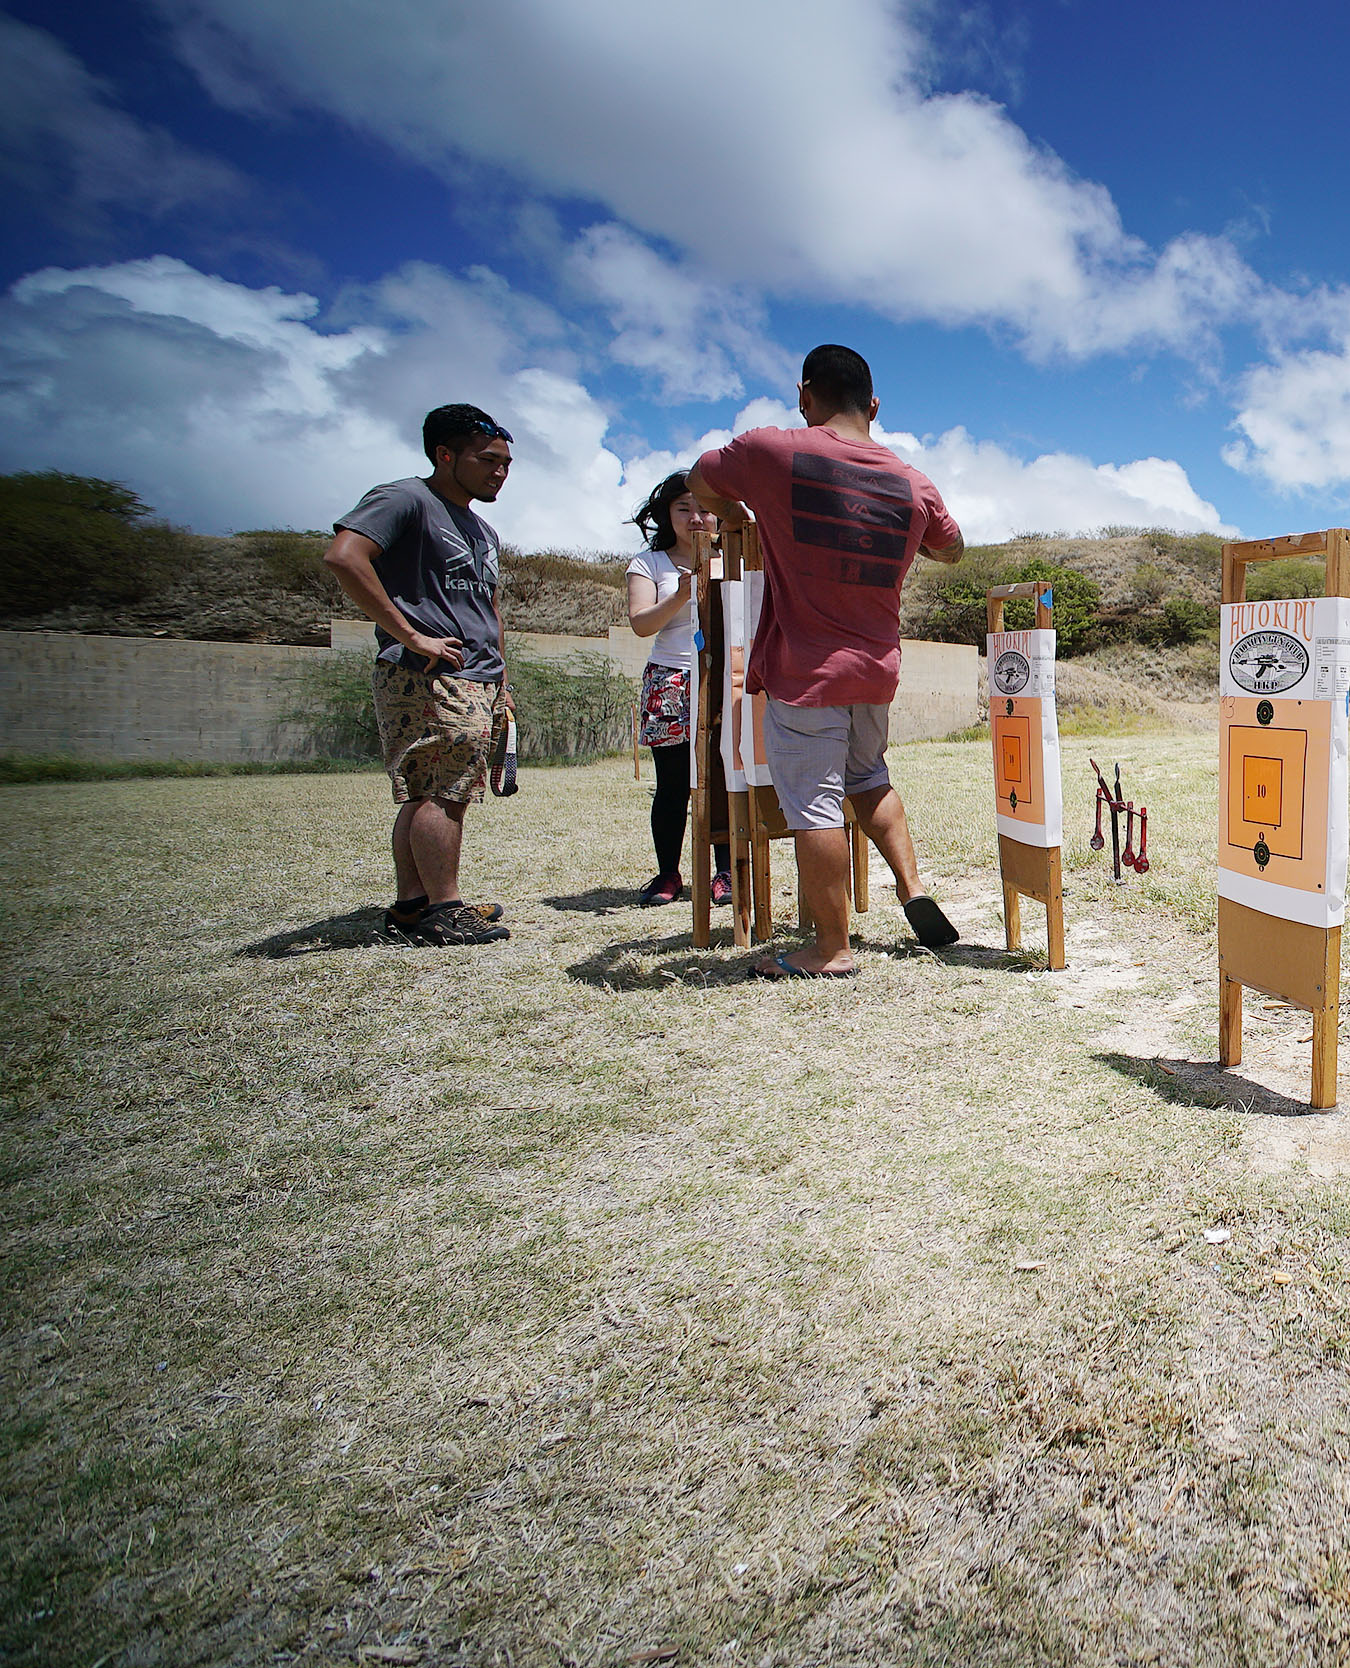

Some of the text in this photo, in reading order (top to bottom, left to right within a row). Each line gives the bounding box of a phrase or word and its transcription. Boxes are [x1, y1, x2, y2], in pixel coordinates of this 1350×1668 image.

[1229, 601, 1316, 646] HUI O KI PU
[1268, 634, 1287, 647] GUN
[1284, 638, 1306, 662] CLUB
[1253, 681, 1278, 691] HKP
[1256, 784, 1267, 799] 10
